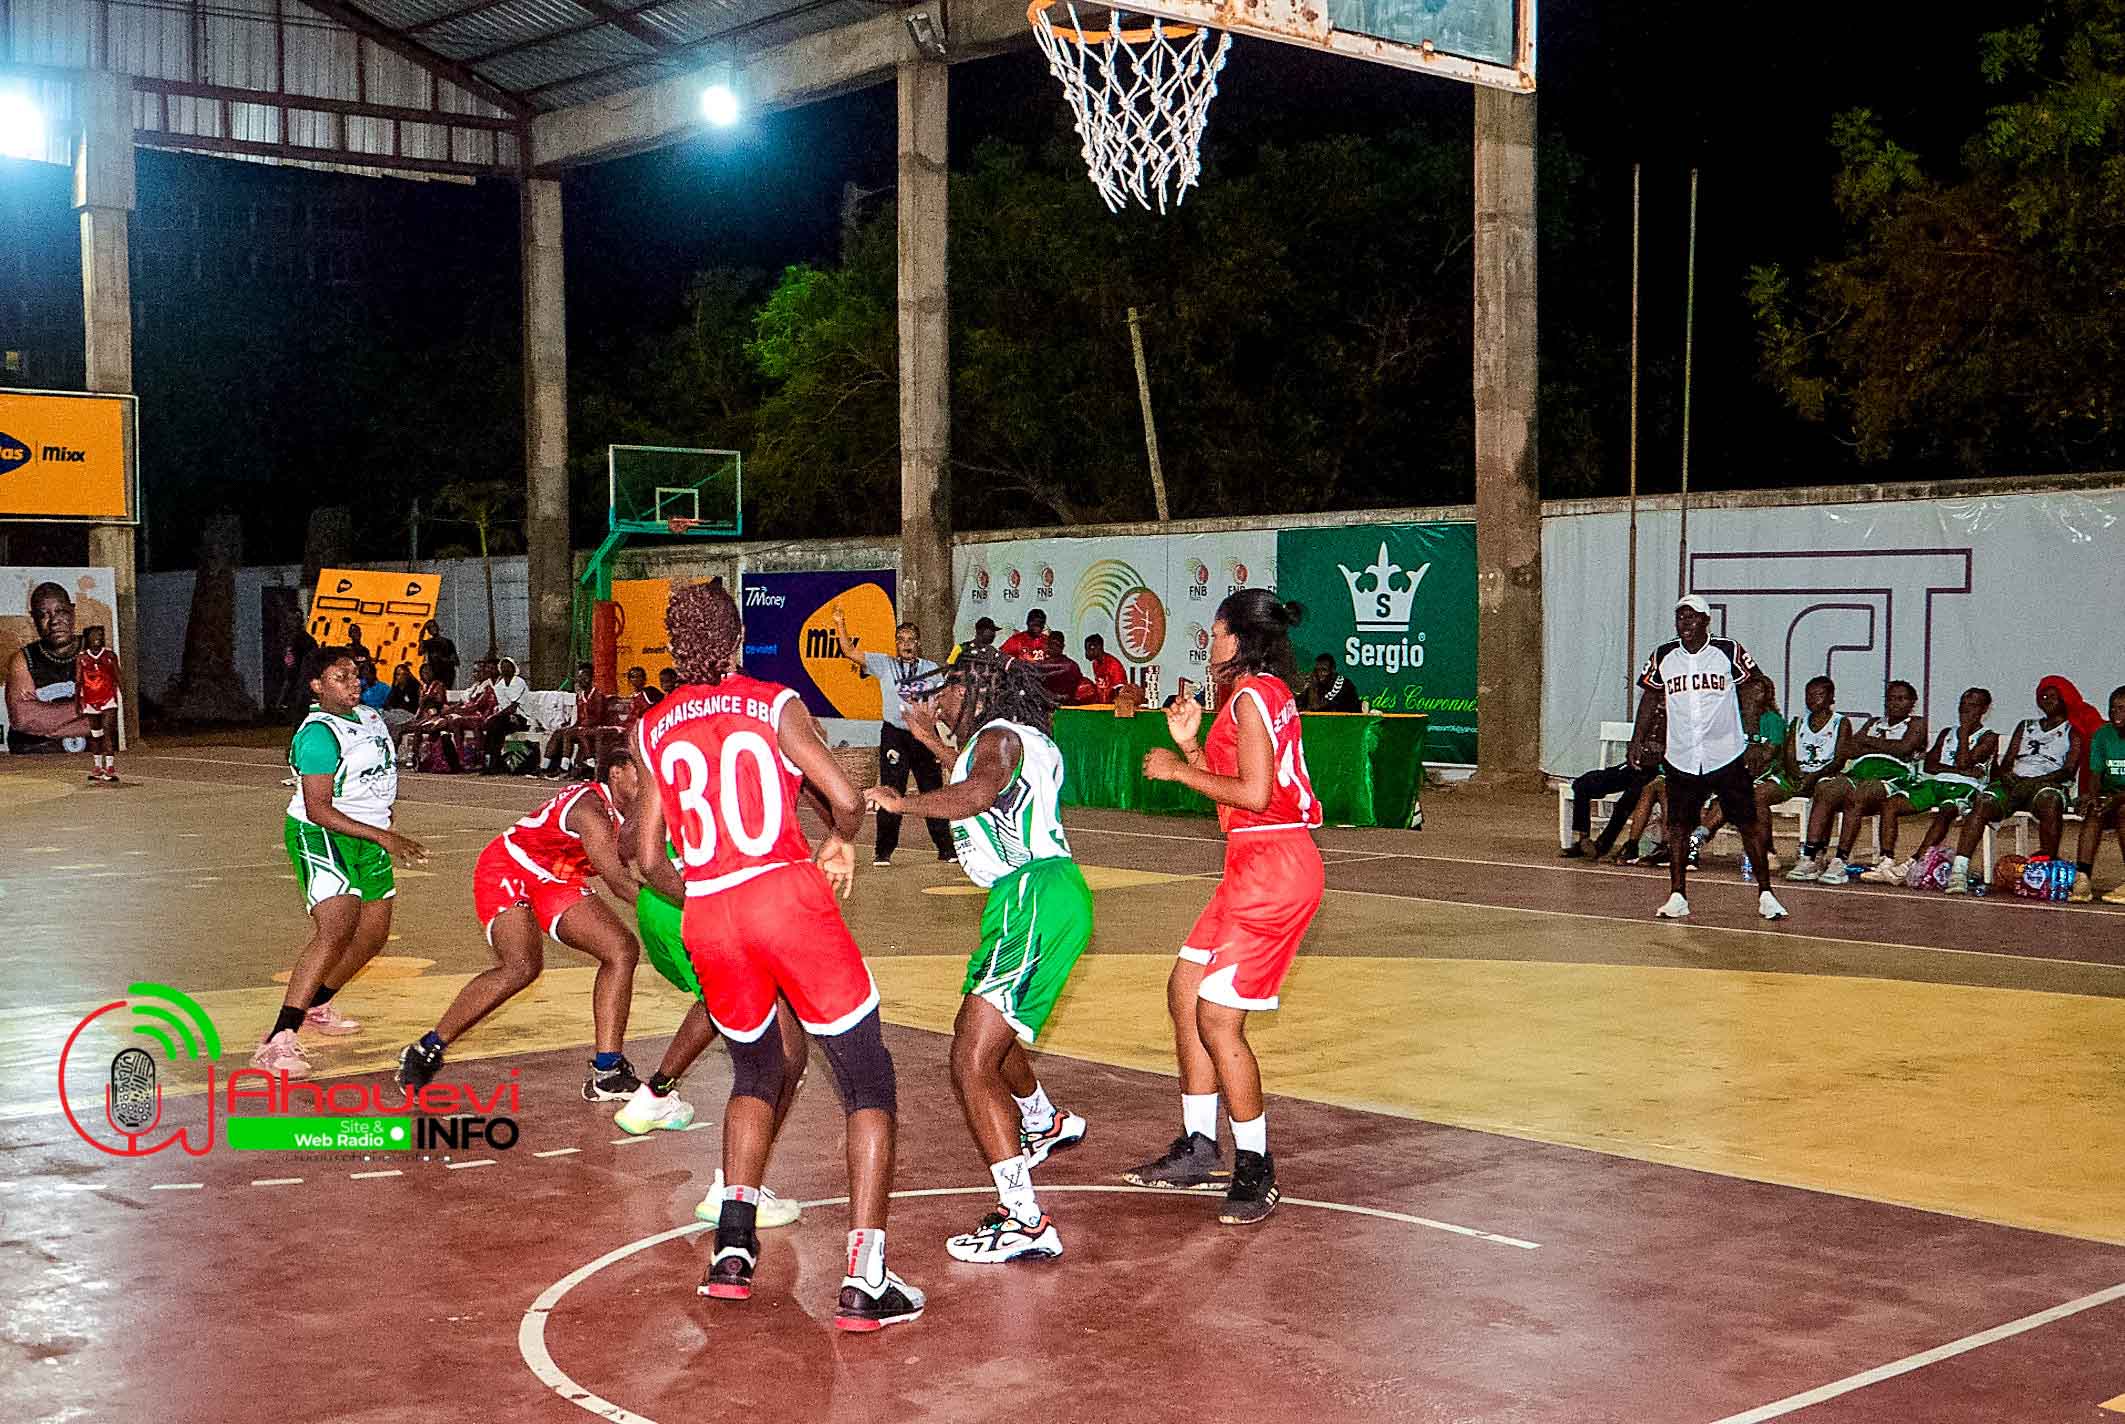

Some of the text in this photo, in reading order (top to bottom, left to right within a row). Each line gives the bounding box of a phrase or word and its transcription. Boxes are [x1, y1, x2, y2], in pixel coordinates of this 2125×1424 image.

[1003, 589, 1020, 599] FNB
[1037, 588, 1053, 597] FNB
[1189, 586, 1208, 596] FNB
[1376, 593, 1391, 617] S
[1189, 650, 1207, 660] FNB
[1345, 636, 1424, 674] Sergio
[650, 695, 742, 749] RENAISSANCE
[660, 731, 783, 867] 30
